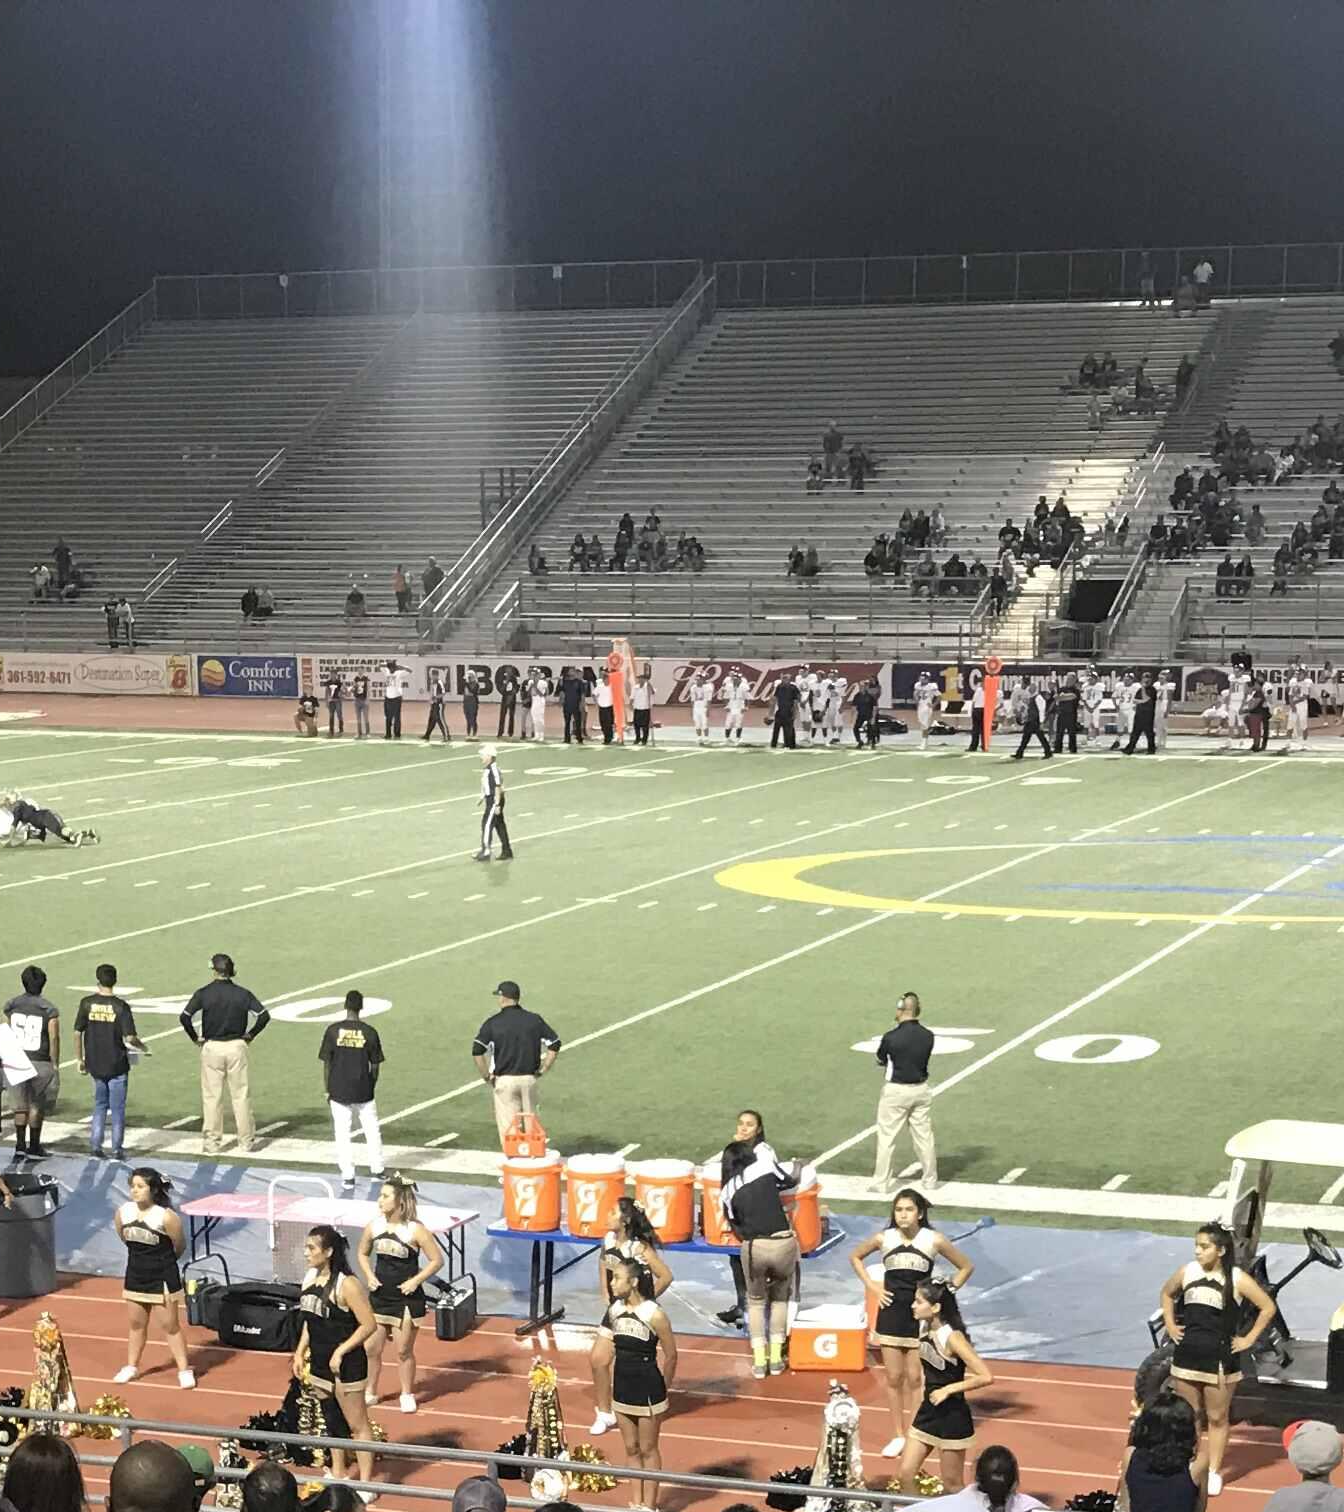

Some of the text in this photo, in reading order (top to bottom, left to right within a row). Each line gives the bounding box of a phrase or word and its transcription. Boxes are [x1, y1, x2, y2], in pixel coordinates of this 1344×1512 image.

[229, 660, 293, 679] Comfort
[248, 680, 273, 692] INN
[520, 1180, 537, 1200] G
[579, 1183, 596, 1203] G
[646, 1188, 664, 1208] G
[813, 1333, 838, 1358] G
